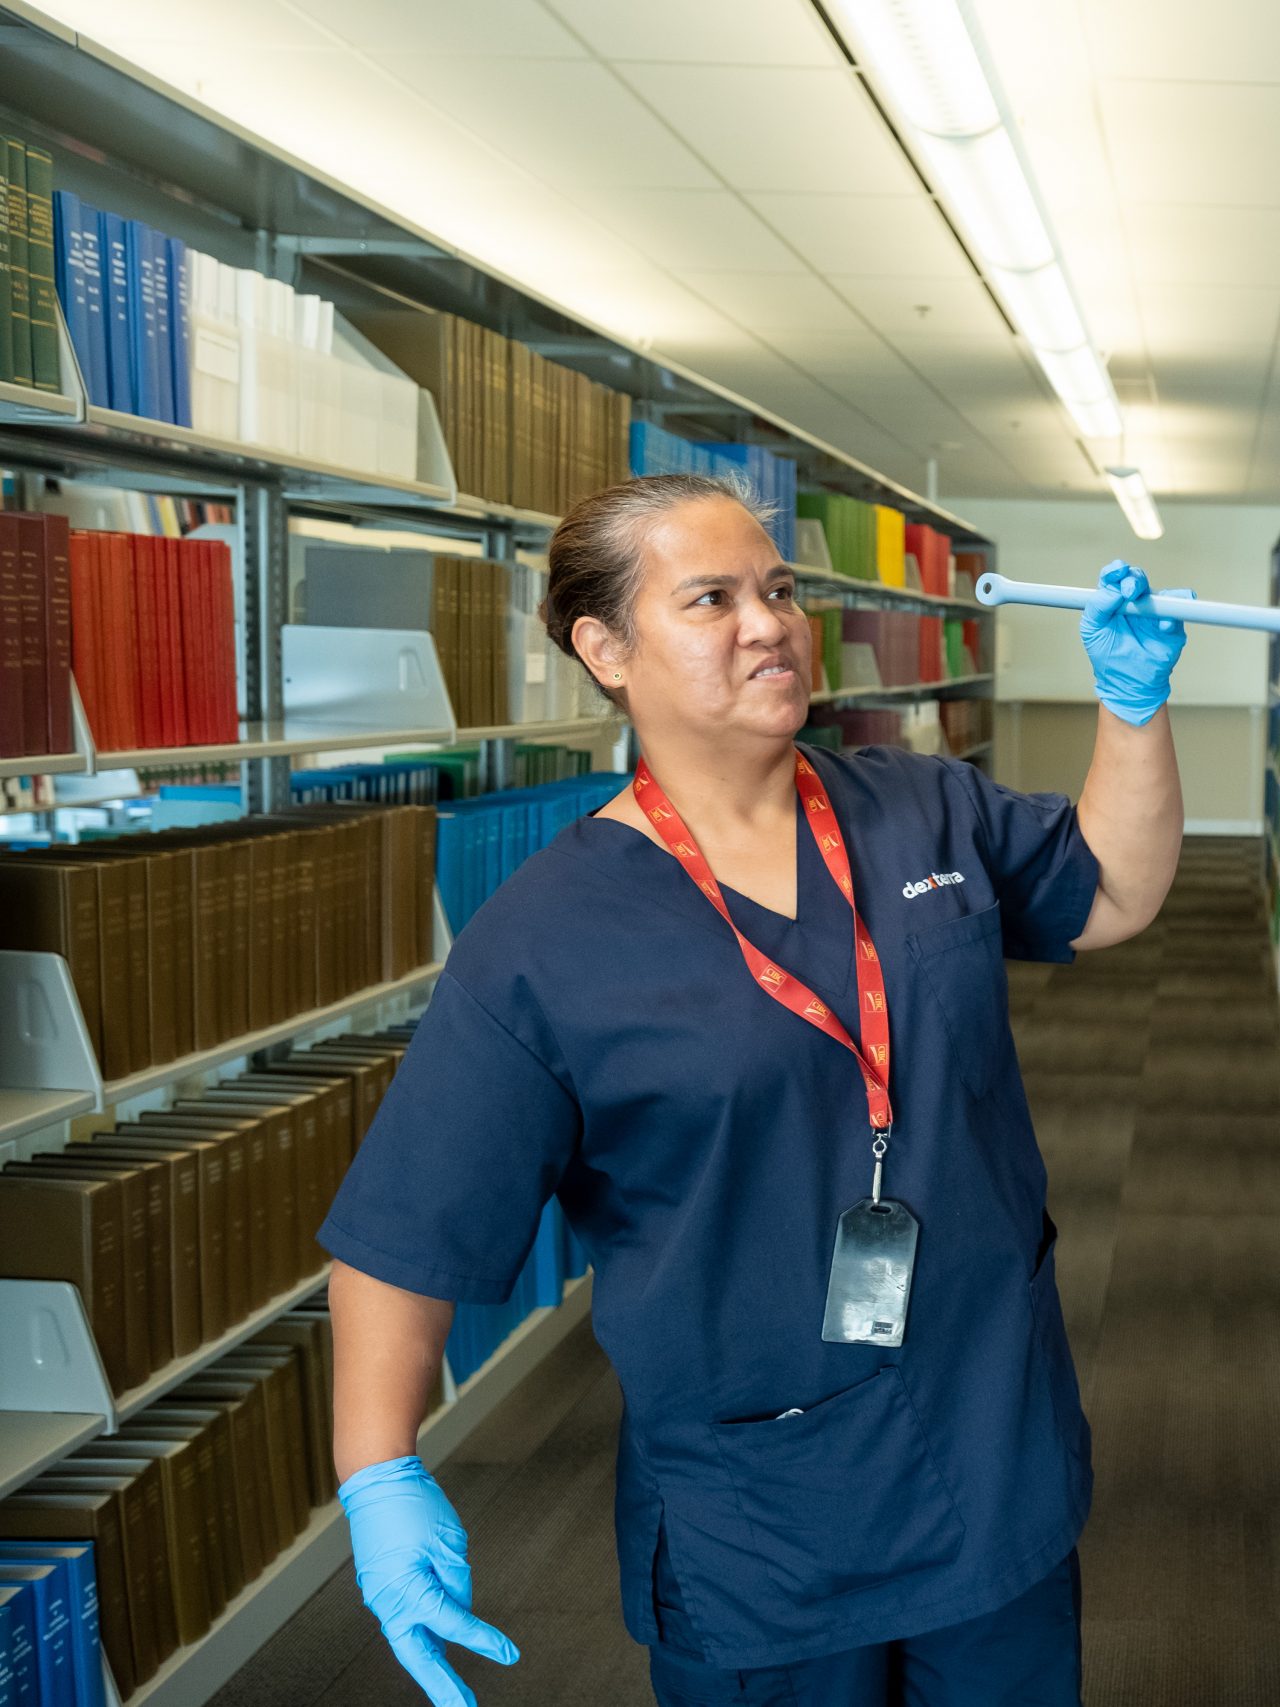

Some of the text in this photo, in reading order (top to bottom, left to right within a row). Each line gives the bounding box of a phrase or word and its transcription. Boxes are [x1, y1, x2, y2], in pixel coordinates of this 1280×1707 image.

[767, 967, 784, 983] CIBC
[812, 1001, 828, 1017] CIBC
[874, 993, 883, 1012] CIBC
[877, 1045, 886, 1065] CIBC
